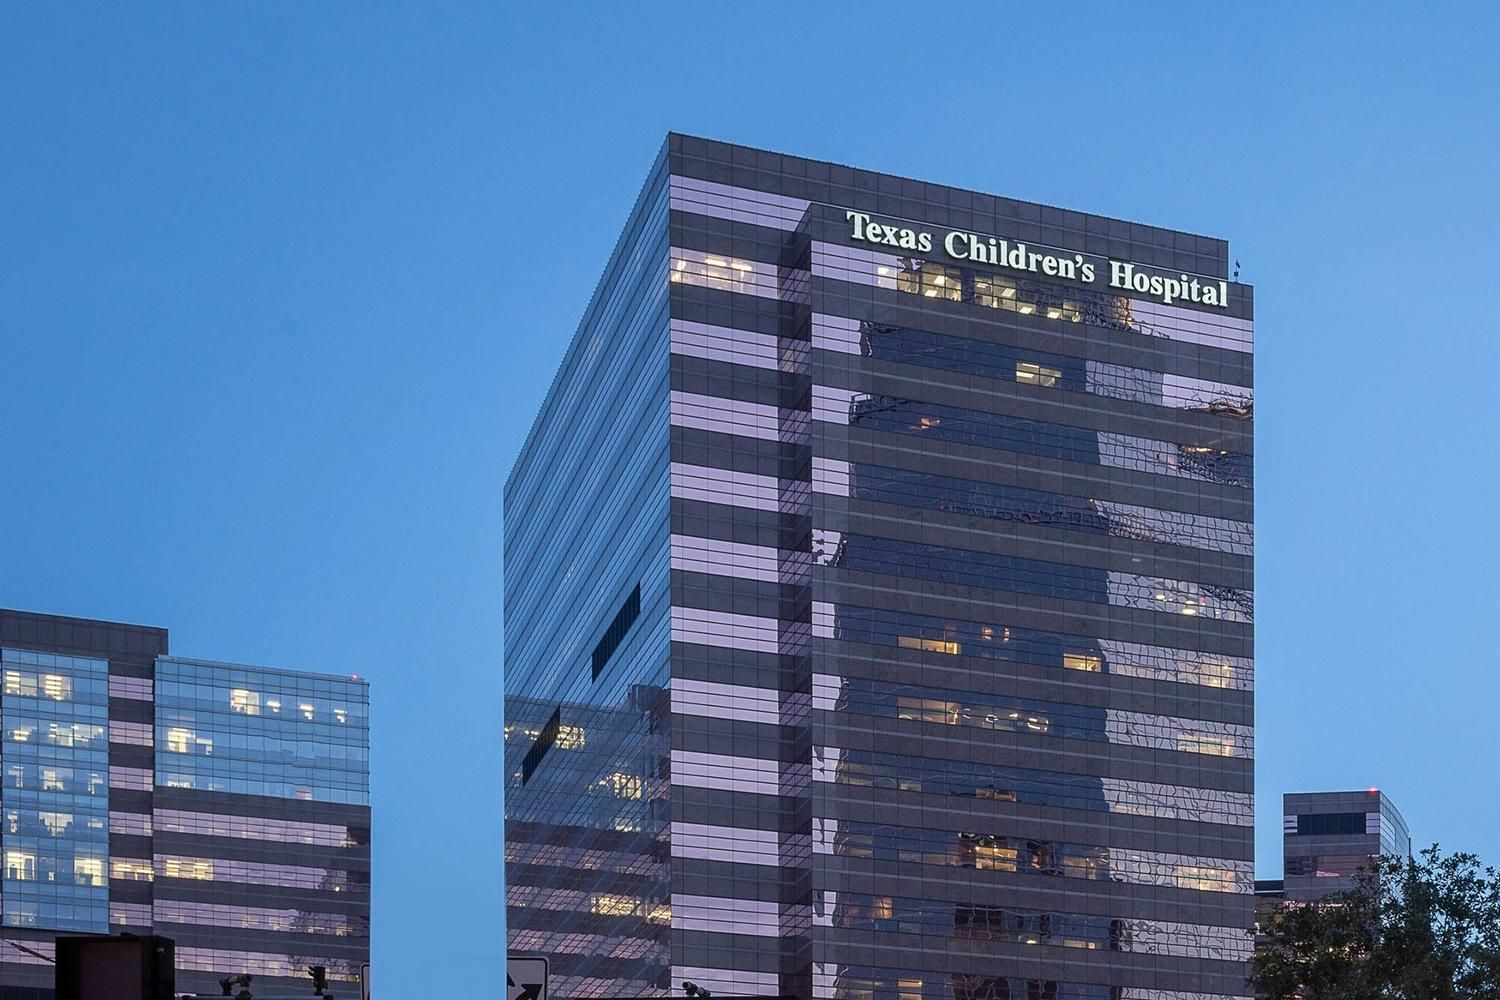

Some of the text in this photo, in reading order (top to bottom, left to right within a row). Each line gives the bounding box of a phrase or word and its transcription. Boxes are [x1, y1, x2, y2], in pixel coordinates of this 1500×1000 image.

[847, 210, 1229, 308] Texas Children's Hospital
